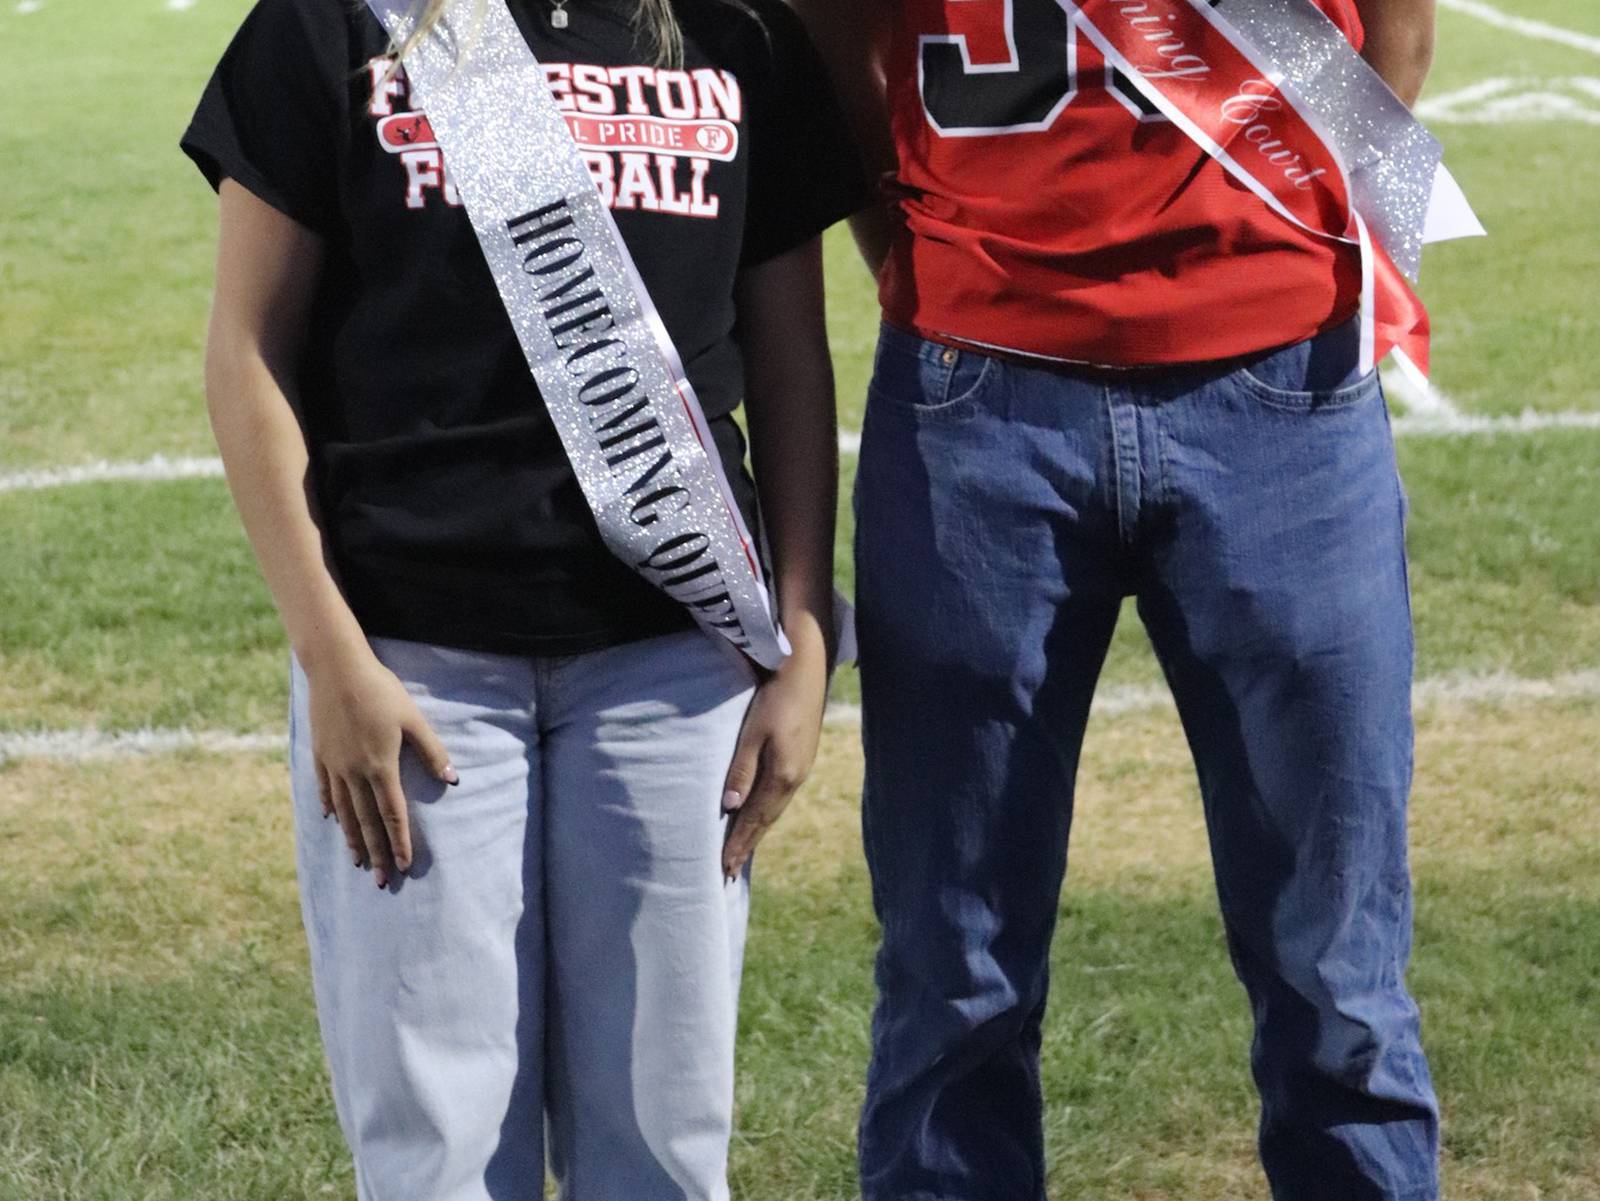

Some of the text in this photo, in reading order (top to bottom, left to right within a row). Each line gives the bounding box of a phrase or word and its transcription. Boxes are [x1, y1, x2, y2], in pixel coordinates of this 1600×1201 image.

[367, 57, 742, 123] FESTON
[598, 122, 684, 146] PRIDE
[1220, 79, 1328, 191] Court
[506, 198, 692, 527] HOMECOMING
